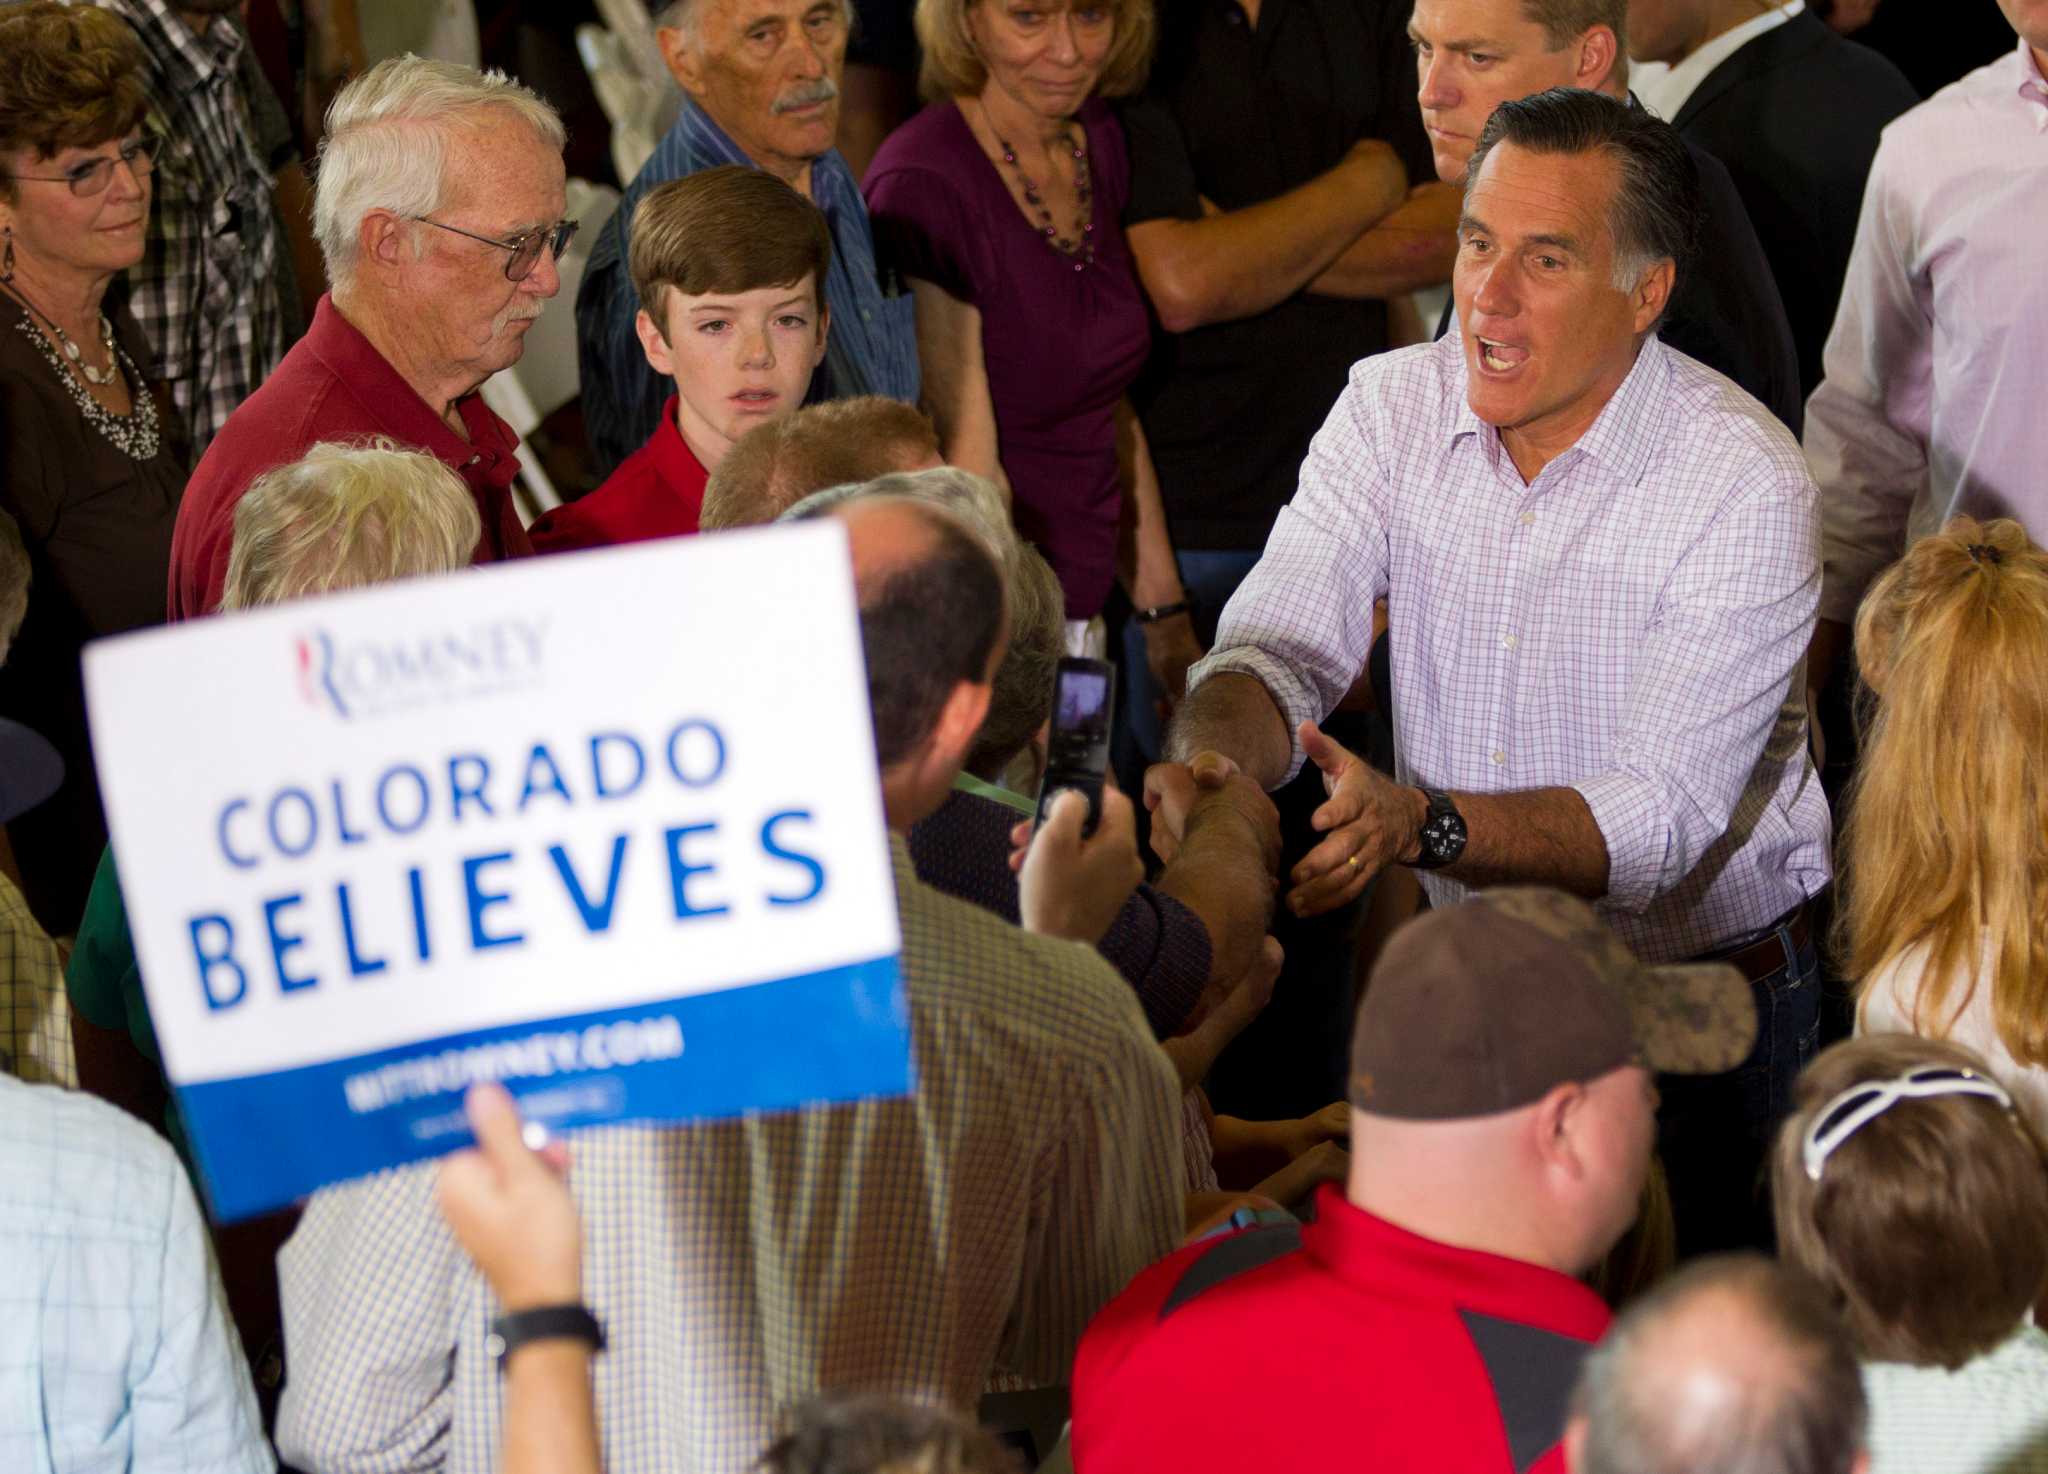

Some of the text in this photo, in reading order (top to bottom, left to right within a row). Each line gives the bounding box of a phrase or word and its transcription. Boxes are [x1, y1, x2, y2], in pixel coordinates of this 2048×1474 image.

[296, 614, 554, 718] ROMNEY
[217, 718, 727, 869] COLORADO
[187, 810, 827, 1013] BELIEVES
[344, 1014, 684, 1112] MITTROMNEY.COM
